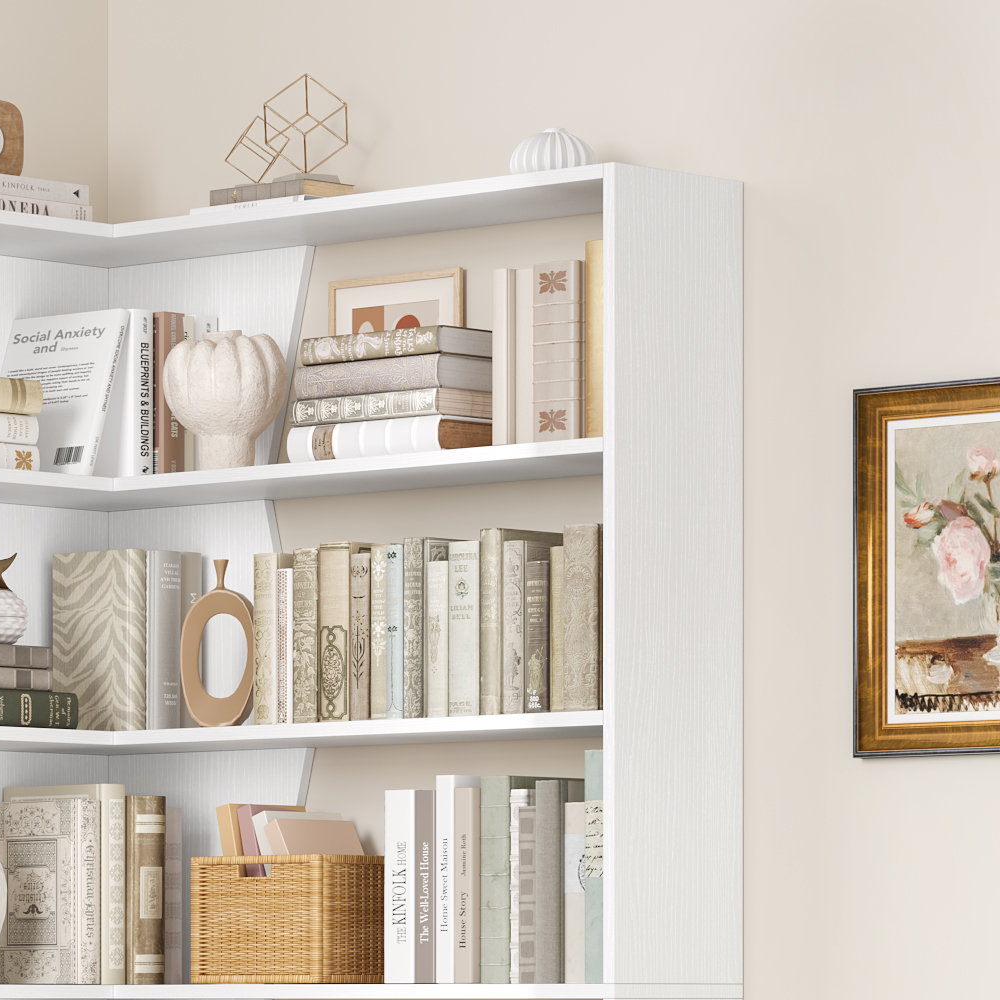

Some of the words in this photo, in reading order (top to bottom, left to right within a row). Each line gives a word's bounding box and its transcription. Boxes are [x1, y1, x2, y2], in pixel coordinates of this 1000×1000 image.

[2, 180, 35, 192] KINFOLK
[13, 328, 50, 345] Social
[54, 326, 106, 341] Anxiety
[33, 341, 57, 354] and
[140, 342, 149, 397] BLUEPRINTS
[141, 410, 149, 457] BUILDINGS
[454, 565, 468, 573] LEE
[397, 842, 406, 866] HOME
[420, 842, 429, 870] House
[440, 838, 448, 872] Maison
[392, 868, 406, 925] KINFOLK
[420, 873, 429, 923] Well-Loved
[459, 891, 468, 916] Story
[397, 927, 406, 944] THE
[420, 926, 429, 944] The
